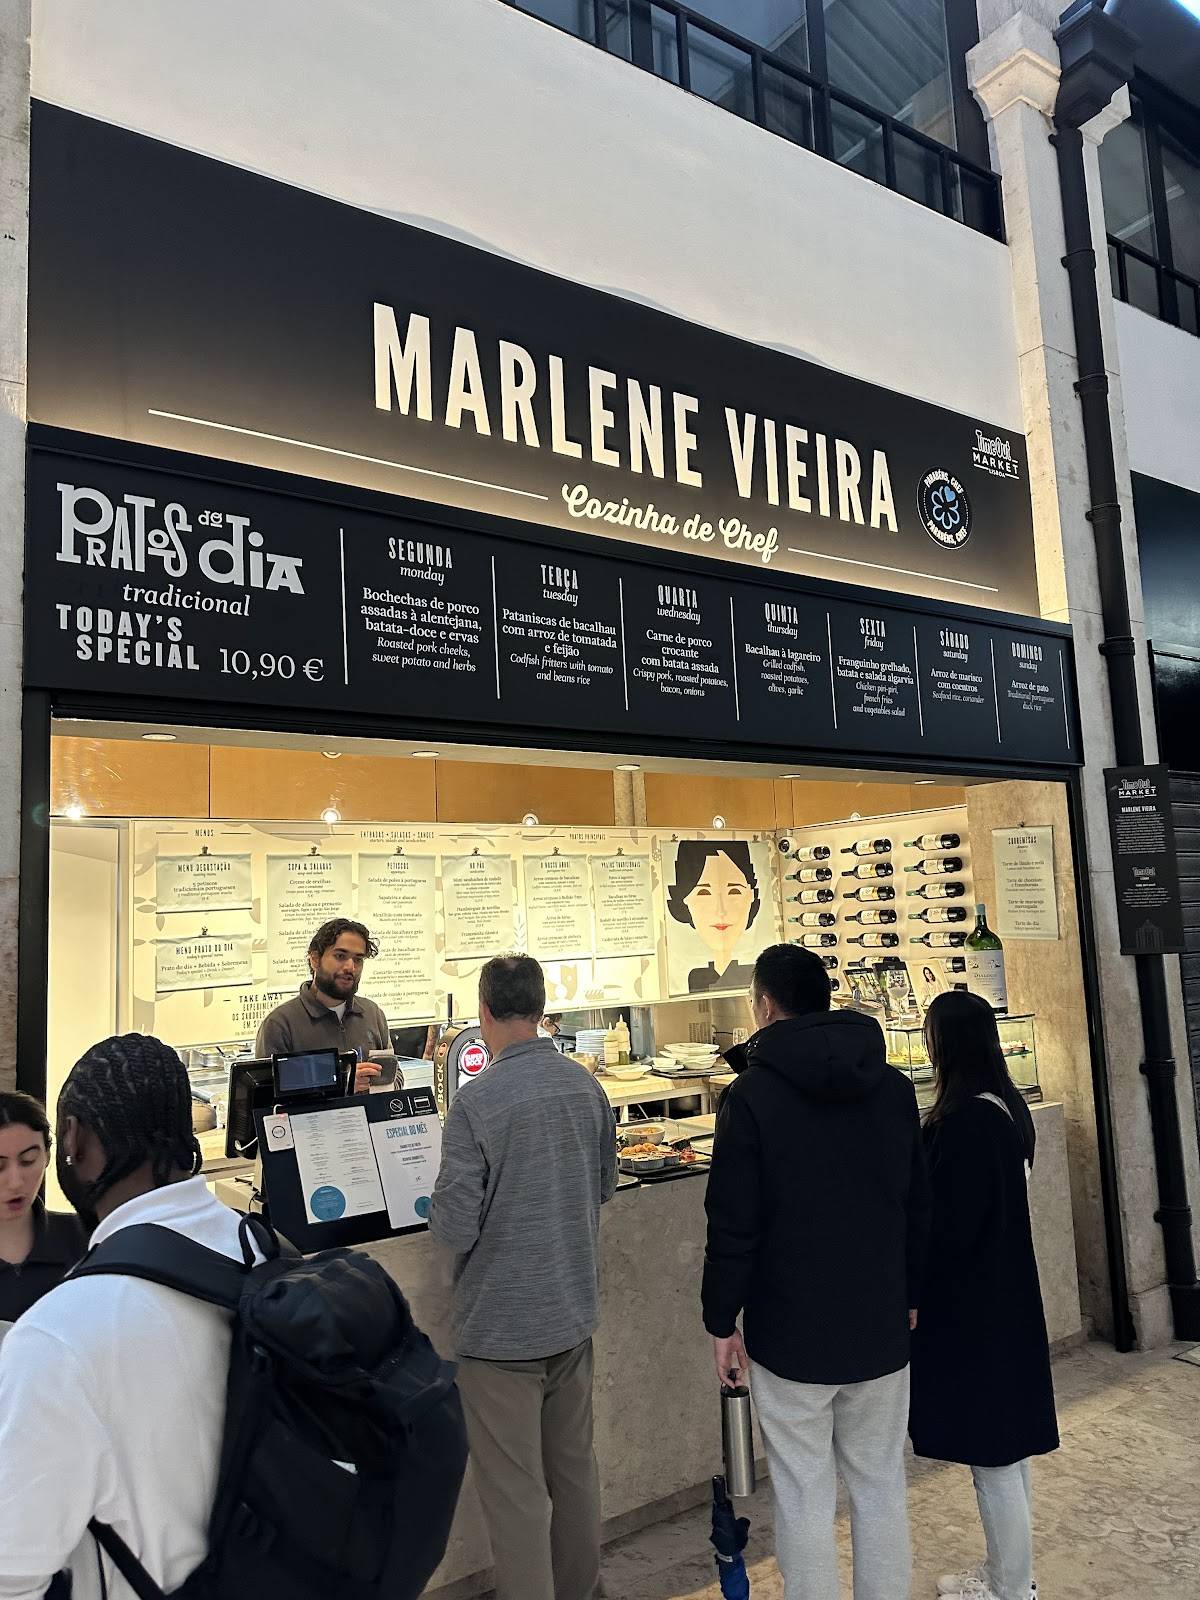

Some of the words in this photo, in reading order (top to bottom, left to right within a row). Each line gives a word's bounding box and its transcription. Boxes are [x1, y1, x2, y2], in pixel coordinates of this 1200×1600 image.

[373, 302, 702, 488] MARLENE
[724, 407, 899, 532] VIEIRA
[972, 452, 1018, 474] MARKET
[988, 469, 1006, 478] LISBOA
[951, 477, 964, 494] CHEF
[198, 510, 223, 528] do
[561, 483, 678, 535] Cozinha
[683, 519, 714, 543] de
[718, 517, 779, 563] Chef
[956, 526, 968, 542] CHEF
[388, 537, 452, 568] SEGUNDA
[400, 566, 445, 586] monday
[541, 564, 578, 592] TERÇA
[123, 583, 250, 616] tradicional
[363, 587, 427, 608] Bochechas
[430, 597, 444, 610] de
[447, 602, 479, 615] porco
[543, 588, 578, 606] tuesday
[658, 585, 697, 608] QUARTA
[361, 605, 407, 620] assadas
[411, 609, 417, 621] à
[421, 611, 482, 631] alentejana,
[502, 608, 556, 626] Pataniscas
[559, 617, 571, 628] de
[573, 618, 616, 635] bacalhau
[657, 606, 700, 624] wednesday
[765, 602, 798, 624] QUINTA
[365, 618, 437, 638] batata-doce
[440, 630, 446, 639] e
[449, 632, 479, 643] ervas
[502, 624, 525, 636] com
[528, 628, 555, 640] arroz
[558, 630, 570, 642] de
[572, 634, 617, 648] tomatada
[768, 622, 797, 639] thursday
[860, 618, 885, 637] SEXTA
[377, 637, 414, 650] Roasted
[417, 642, 437, 654] pork
[439, 643, 471, 658] cheeks,
[646, 630, 673, 642] Carne
[675, 633, 686, 644] de
[688, 636, 712, 647] porco
[864, 636, 884, 651] friday
[940, 628, 969, 650] SÁBADO
[76, 634, 200, 670] SPECIAL
[545, 644, 550, 653] e
[553, 643, 580, 657] feijão
[662, 646, 699, 658] crocante
[745, 643, 780, 657] Bacalhau
[782, 648, 786, 658] à
[788, 649, 821, 662] lagareiro
[943, 650, 968, 663] saturday
[1012, 642, 1042, 661] DOMINGO
[219, 648, 296, 680] 10,90
[302, 658, 325, 682] €
[372, 653, 399, 664] sweet
[402, 656, 431, 668] potato
[433, 658, 450, 669] and
[453, 659, 476, 672] herbs
[510, 653, 540, 667] Codfish
[542, 656, 567, 669] fritters
[570, 660, 586, 671] with
[588, 664, 614, 674] tomato
[641, 657, 660, 665] com
[662, 657, 689, 670] batata
[692, 663, 719, 673] assada
[763, 659, 782, 669] Grilled
[784, 662, 805, 673] codfish,
[838, 656, 879, 669] Franguinho
[881, 662, 911, 674] grelhado,
[1020, 661, 1037, 673] sunday
[536, 670, 552, 680] and
[554, 671, 575, 683] beans
[577, 675, 590, 685] rice
[633, 668, 655, 681] Crispy
[657, 670, 673, 682] pork,
[676, 674, 699, 684] roasted
[701, 677, 728, 687] potatoes,
[761, 672, 782, 681] roasted
[837, 667, 859, 678] batata
[865, 671, 886, 681] salada
[888, 673, 914, 685] algarvia
[931, 668, 949, 678] Arroz
[950, 671, 958, 680] de
[958, 673, 982, 682] marisco
[661, 682, 682, 695] bacon,
[684, 687, 705, 696] onions
[768, 683, 786, 694] olives,
[788, 686, 803, 696] garlic
[856, 681, 876, 691] Chicken
[938, 682, 951, 690] com
[952, 684, 978, 692] coentros
[1012, 680, 1028, 690] Arroz
[1029, 682, 1036, 690] de
[1037, 684, 1049, 693] pato
[864, 693, 880, 704] french
[881, 695, 893, 707] fries
[932, 691, 952, 701] Seafood
[853, 704, 863, 712] and
[892, 708, 905, 716] salad
[195, 945, 211, 953] PRATO
[240, 995, 258, 1003] TAKE
[386, 1125, 409, 1139] ESPECIAL
[409, 1124, 416, 1135] DO
[417, 1122, 428, 1133] MÊS
